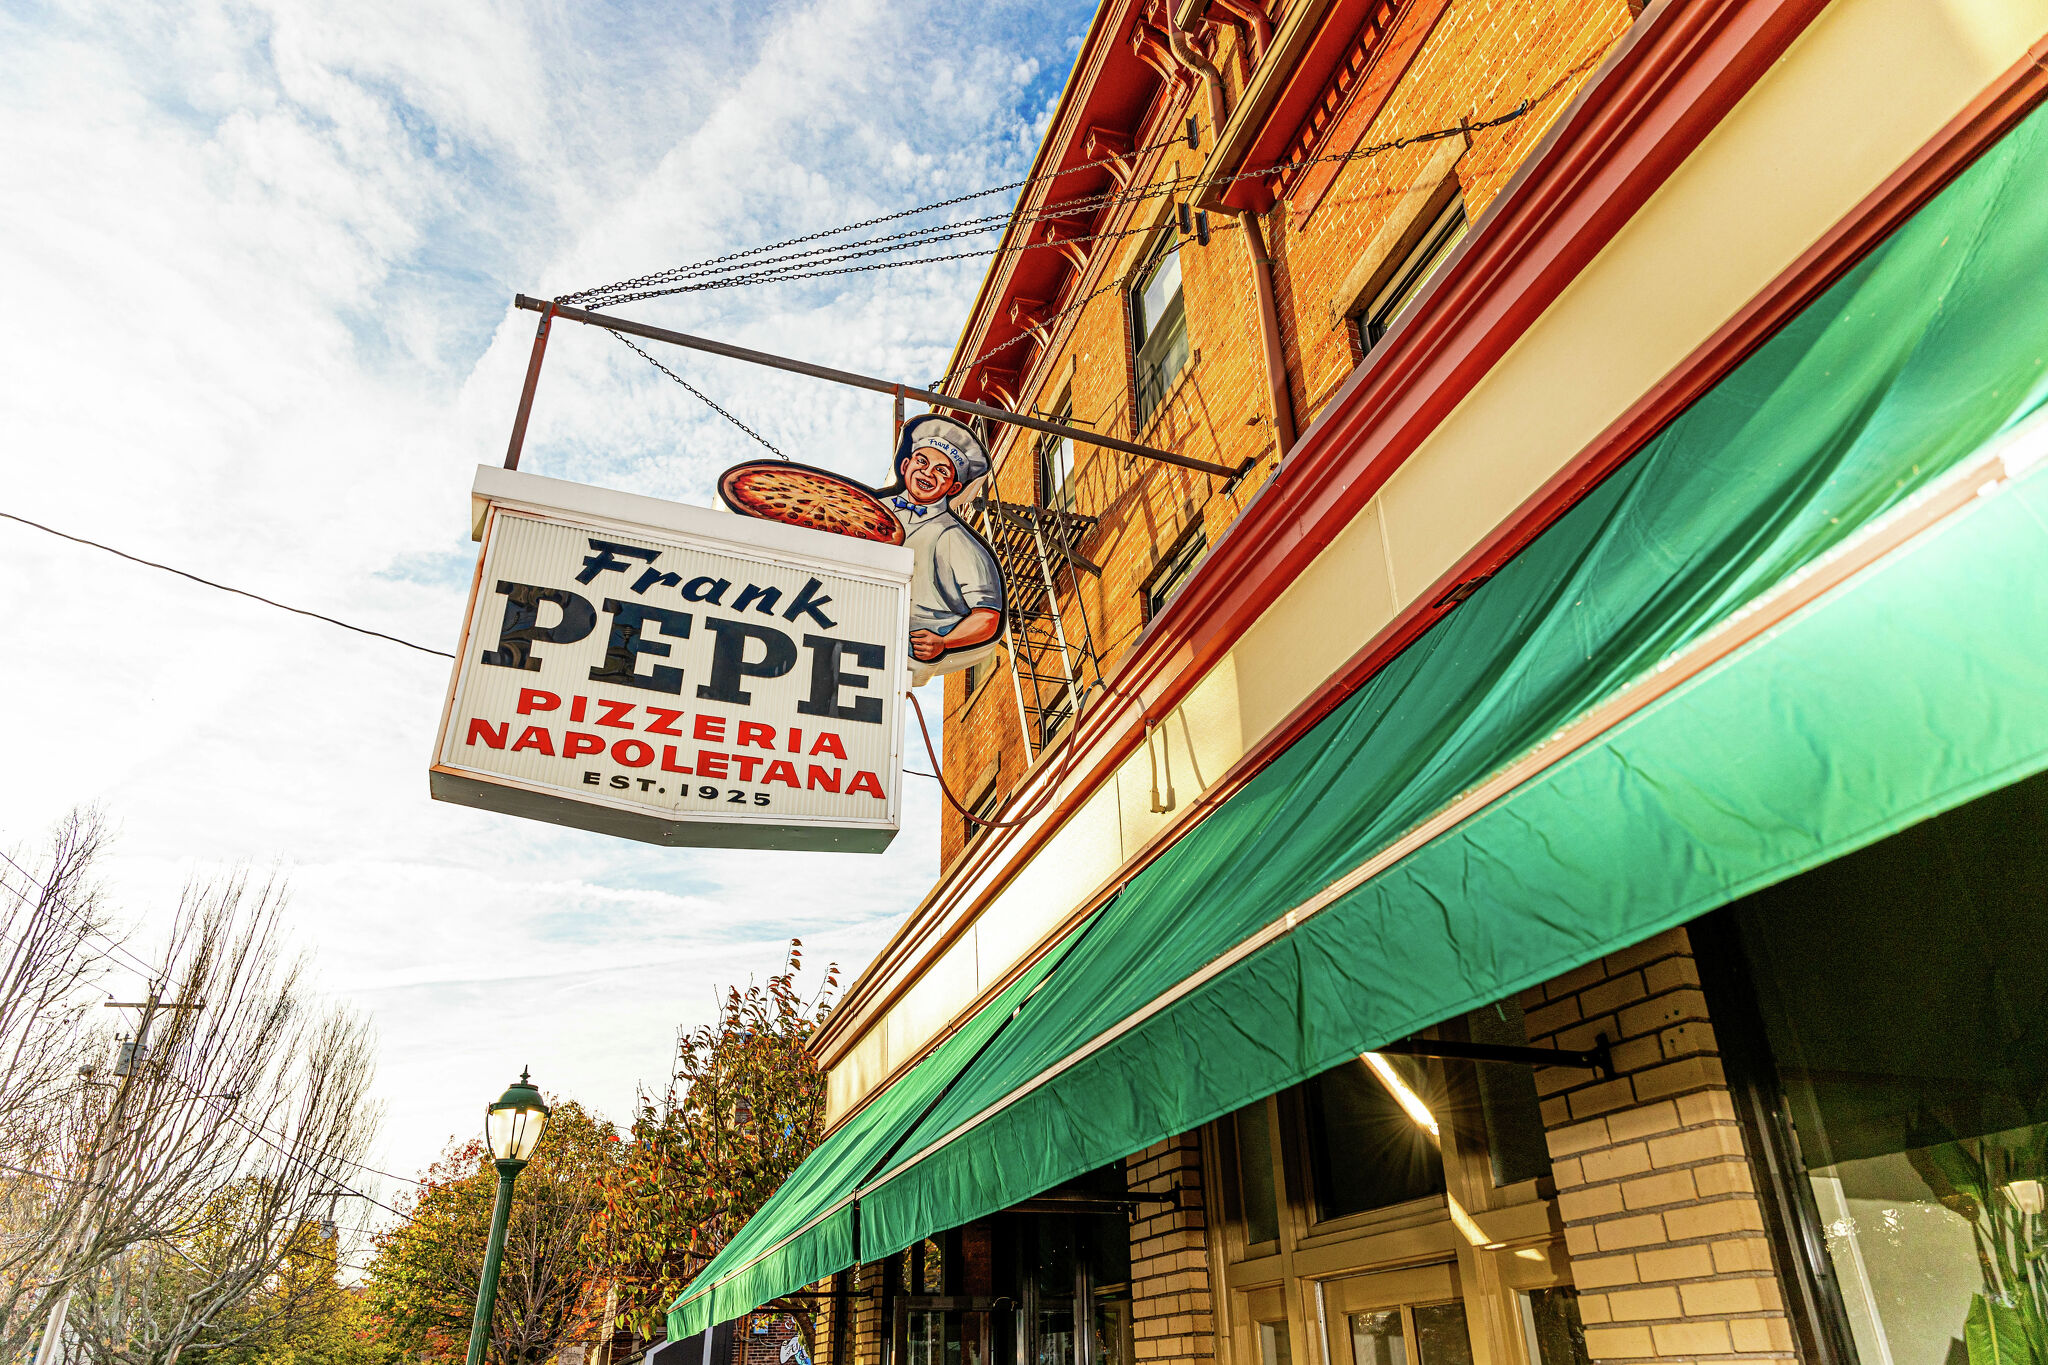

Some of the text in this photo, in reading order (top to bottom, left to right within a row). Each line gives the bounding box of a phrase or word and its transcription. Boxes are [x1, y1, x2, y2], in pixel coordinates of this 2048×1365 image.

[929, 438, 965, 467] Frank Pepe
[575, 538, 838, 630] Frank
[481, 580, 885, 724] PEPE
[466, 718, 886, 799] NAPOLETANA
[516, 687, 848, 760] PIZZERIA
[582, 771, 771, 807] EST. 1925
